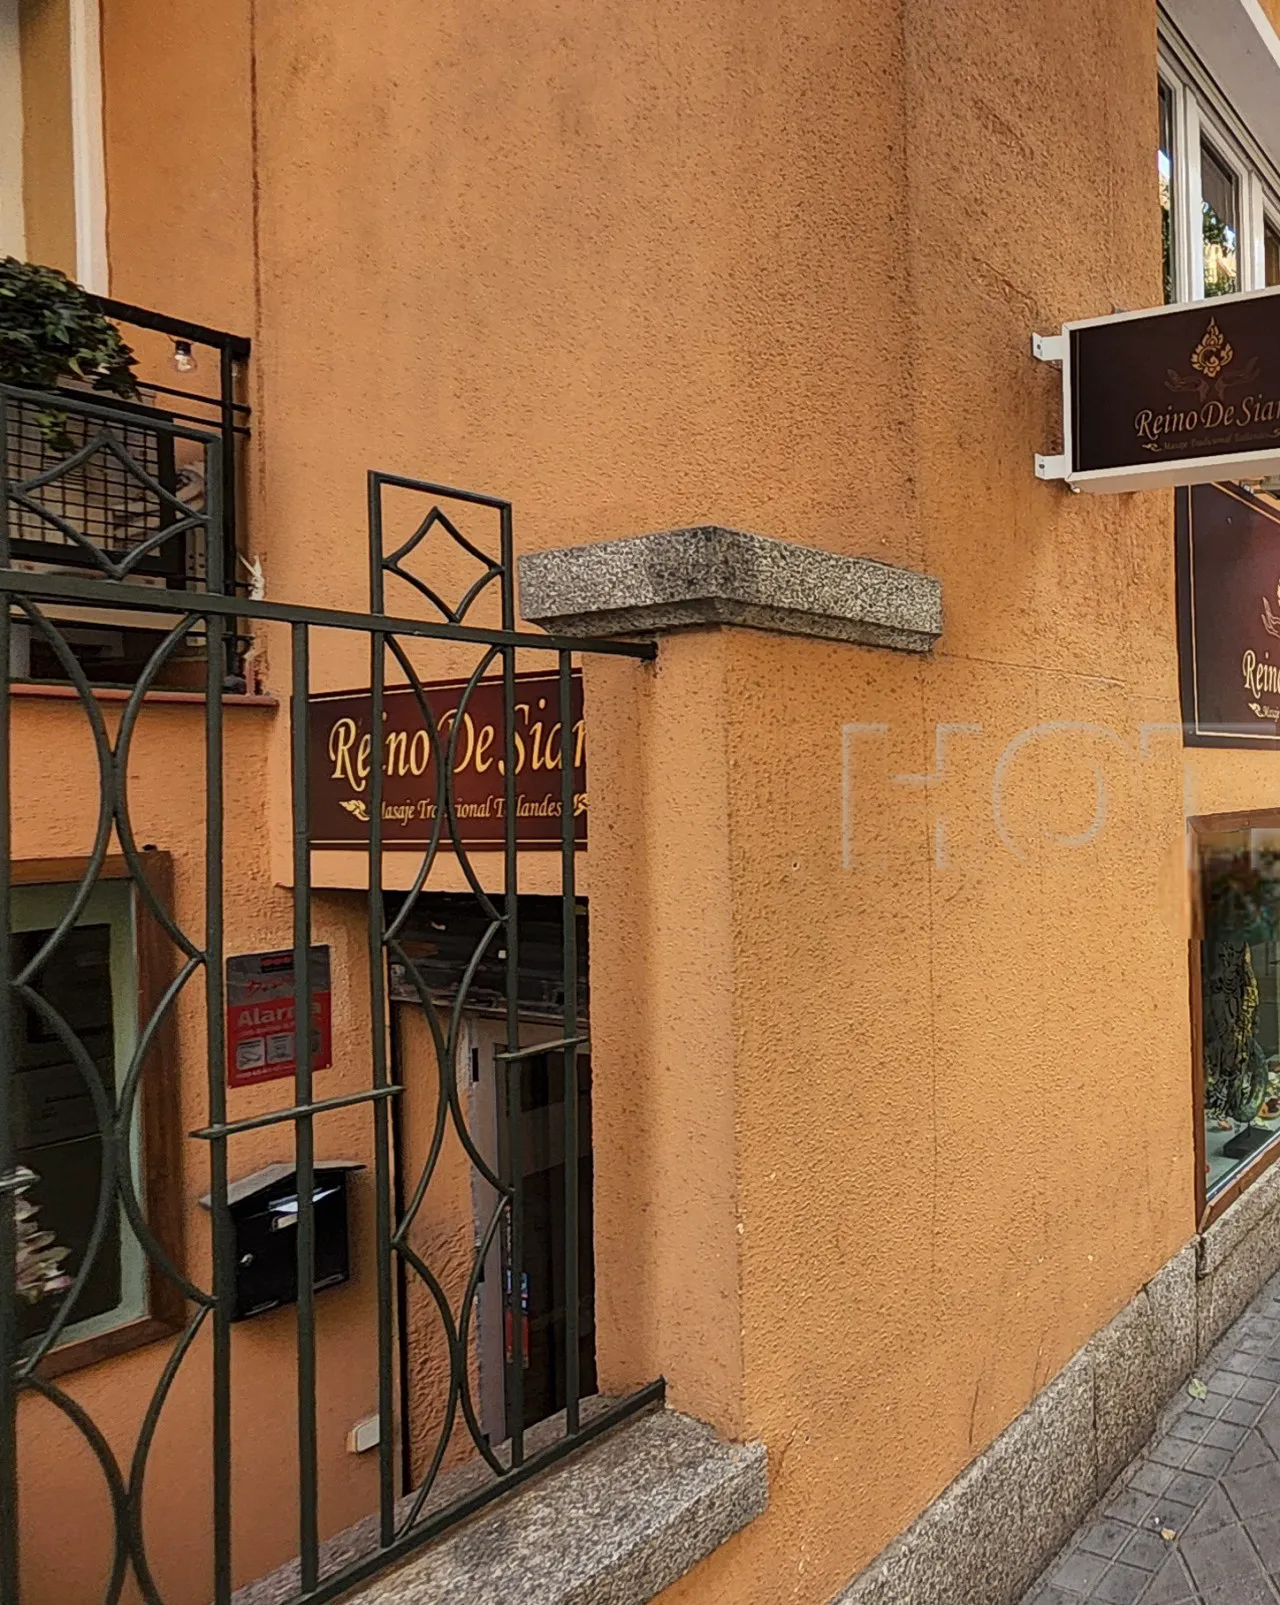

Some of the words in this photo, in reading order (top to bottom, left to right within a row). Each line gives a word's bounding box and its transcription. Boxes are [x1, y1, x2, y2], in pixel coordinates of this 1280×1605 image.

[1134, 405, 1198, 440] Reino
[1201, 400, 1235, 428] De
[329, 711, 430, 792] Reno
[437, 708, 494, 773] De
[381, 799, 415, 826] asaje
[417, 795, 493, 819] Traional
[494, 793, 562, 818] Tlandes
[238, 1001, 322, 1027] Alara
